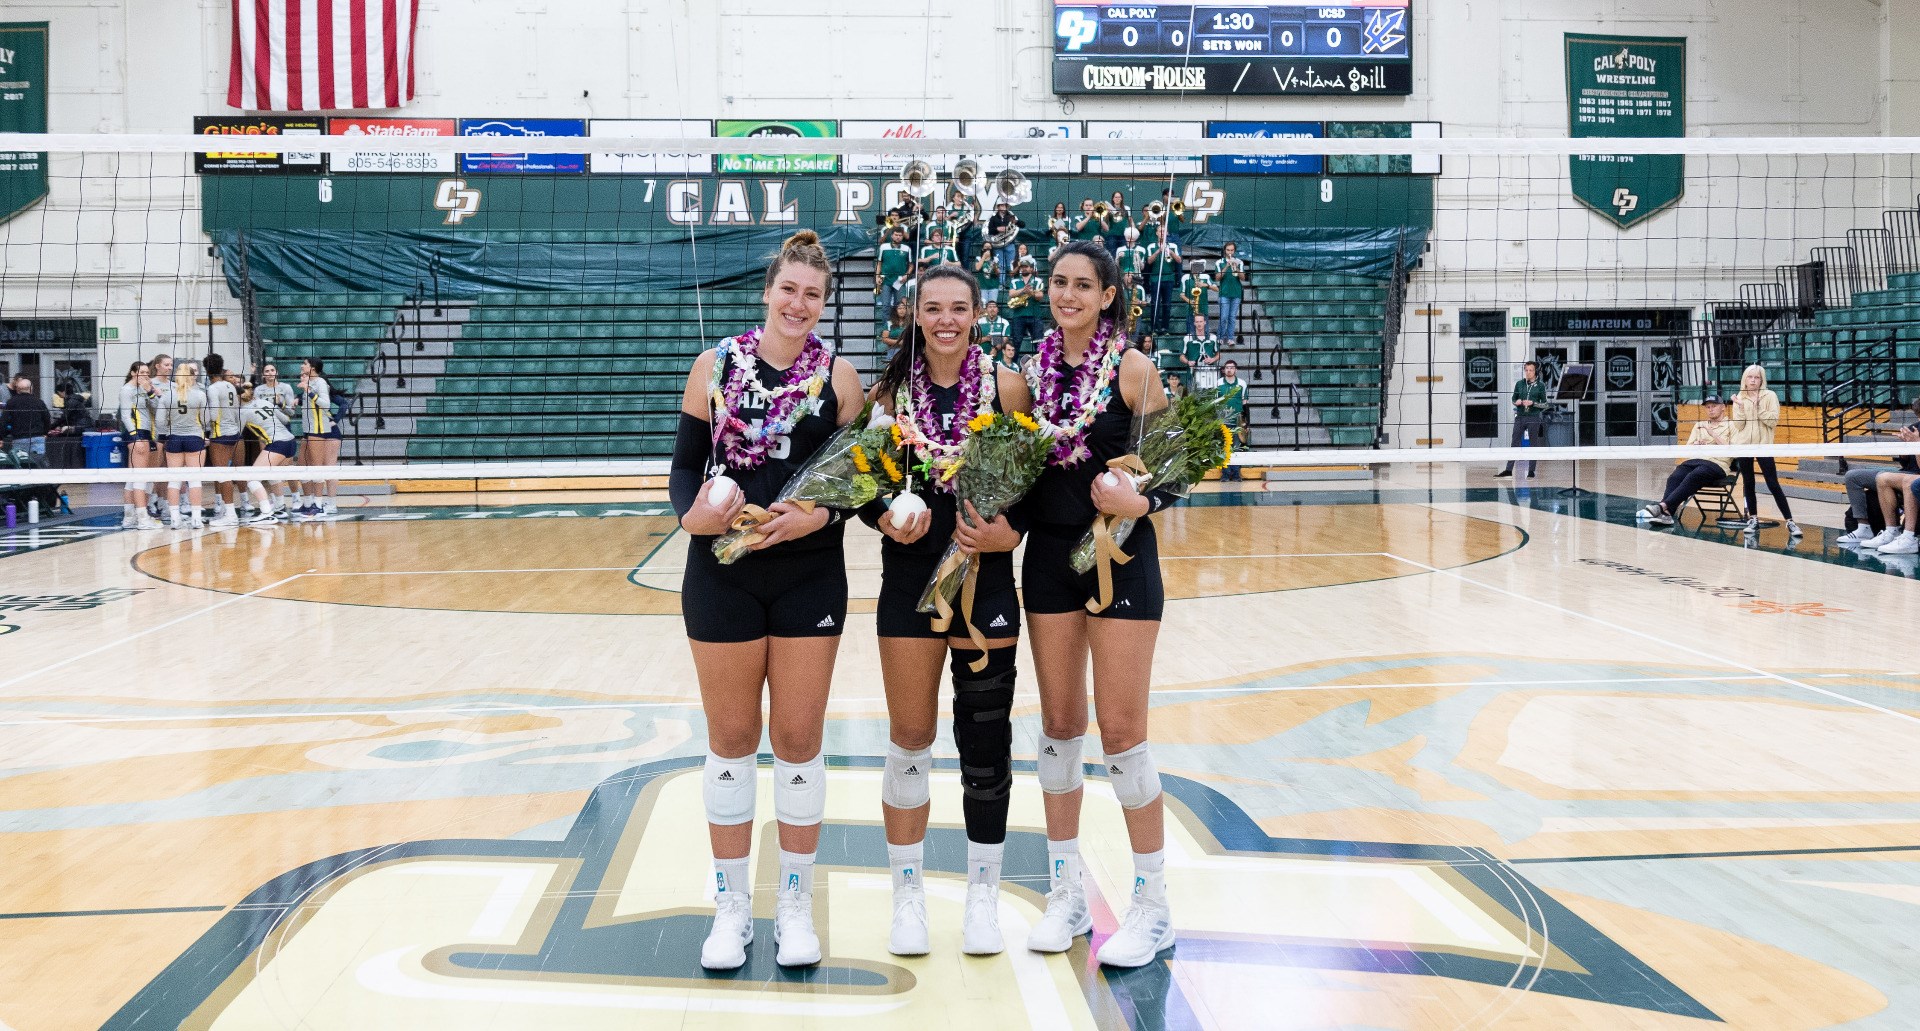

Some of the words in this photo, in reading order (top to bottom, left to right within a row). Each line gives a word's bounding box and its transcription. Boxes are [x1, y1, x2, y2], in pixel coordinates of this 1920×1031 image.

[1107, 8, 1128, 18] CAL
[1129, 9, 1157, 18] POLY
[1319, 9, 1346, 18] UCSD
[1213, 13, 1254, 30] 1:30
[1122, 26, 1139, 47] 0
[1171, 30, 1184, 46] 0
[1281, 31, 1294, 47] 0
[1326, 28, 1342, 47] 0
[1202, 40, 1232, 51] SETS
[1235, 40, 1262, 51] WON
[1594, 55, 1614, 72] CAL
[1629, 54, 1656, 73] POLY
[1083, 64, 1146, 90] CUSTOM
[1147, 65, 1206, 90] HOUSE
[1596, 74, 1656, 85] WRESTLING
[347, 157, 438, 169] 805-546-8393
[318, 180, 332, 202] 6
[643, 179, 656, 202] 7
[1320, 179, 1333, 202] 9
[666, 179, 798, 225] CAL
[1514, 317, 1528, 328] EXIT
[228, 391, 234, 406] 9
[177, 400, 188, 415] 5
[254, 405, 275, 421] 16
